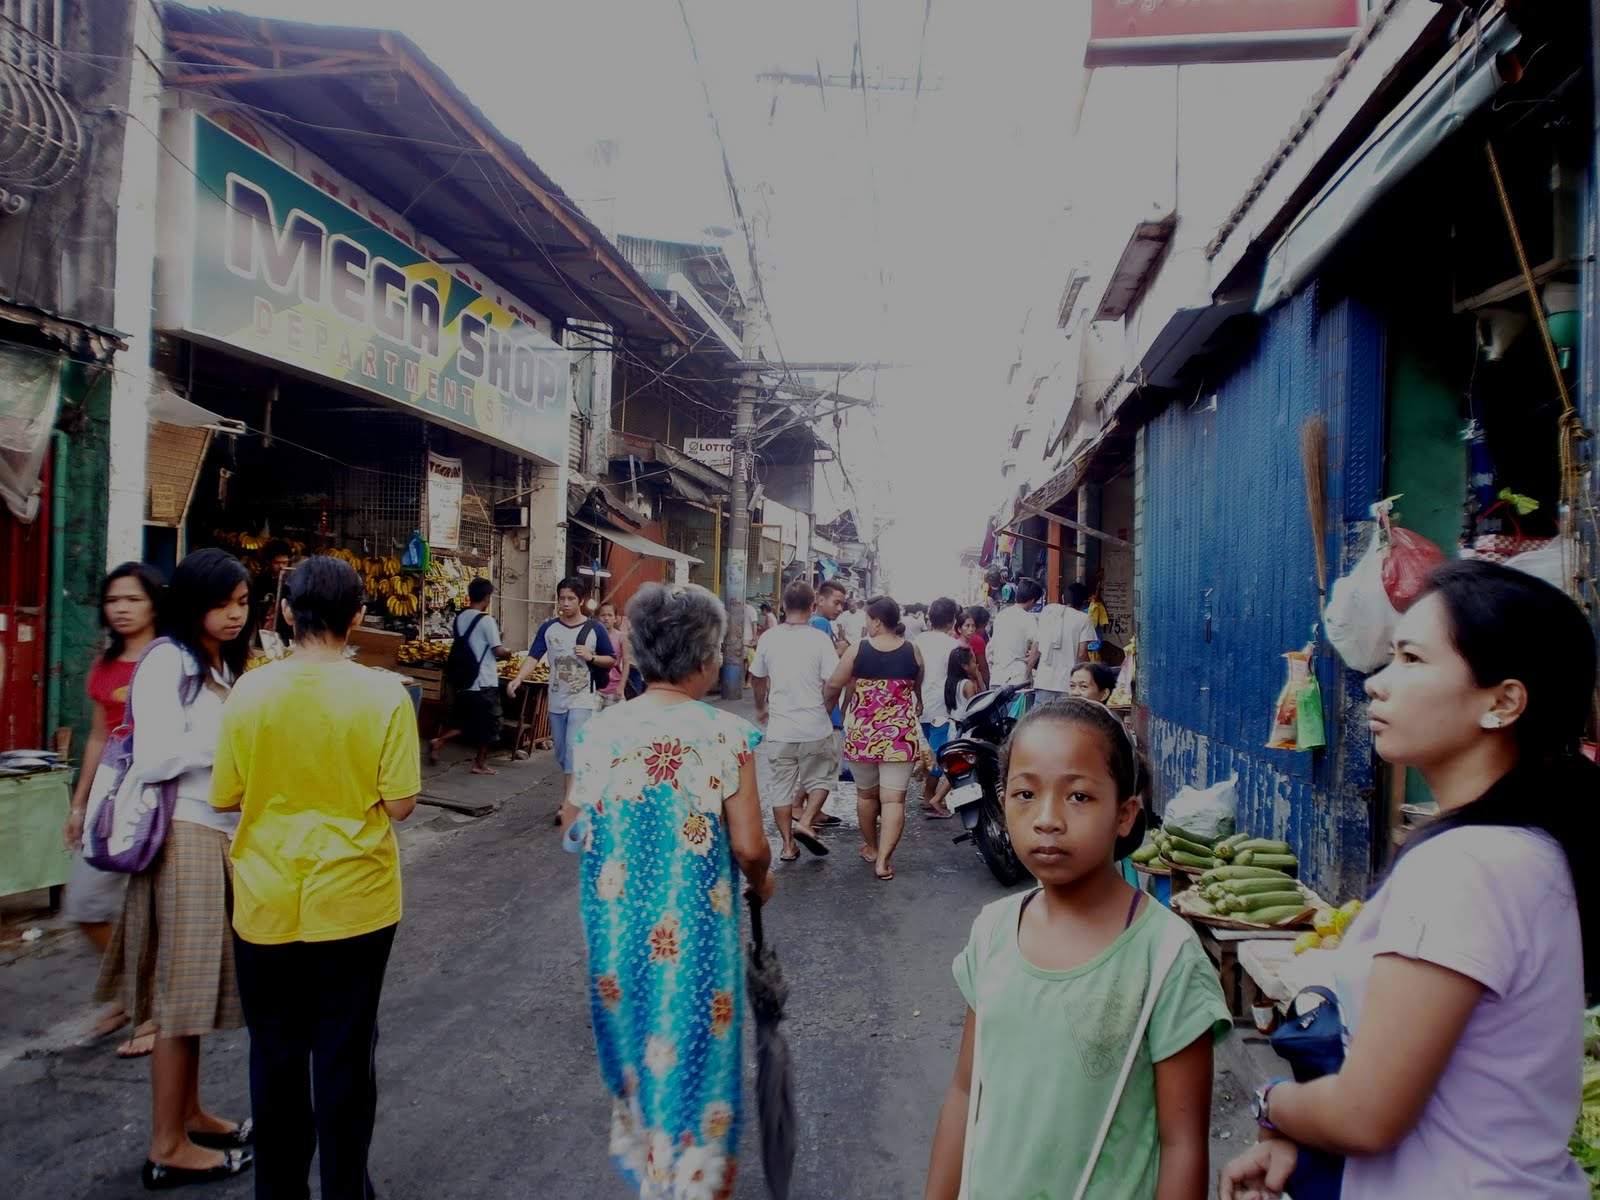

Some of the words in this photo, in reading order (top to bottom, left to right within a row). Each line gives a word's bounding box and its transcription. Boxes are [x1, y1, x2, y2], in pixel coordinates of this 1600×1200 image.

[224, 172, 441, 361] MEGA
[456, 309, 559, 411] SHOP
[254, 296, 474, 416] DEPARTMENT
[700, 444, 733, 452] LOTTO
